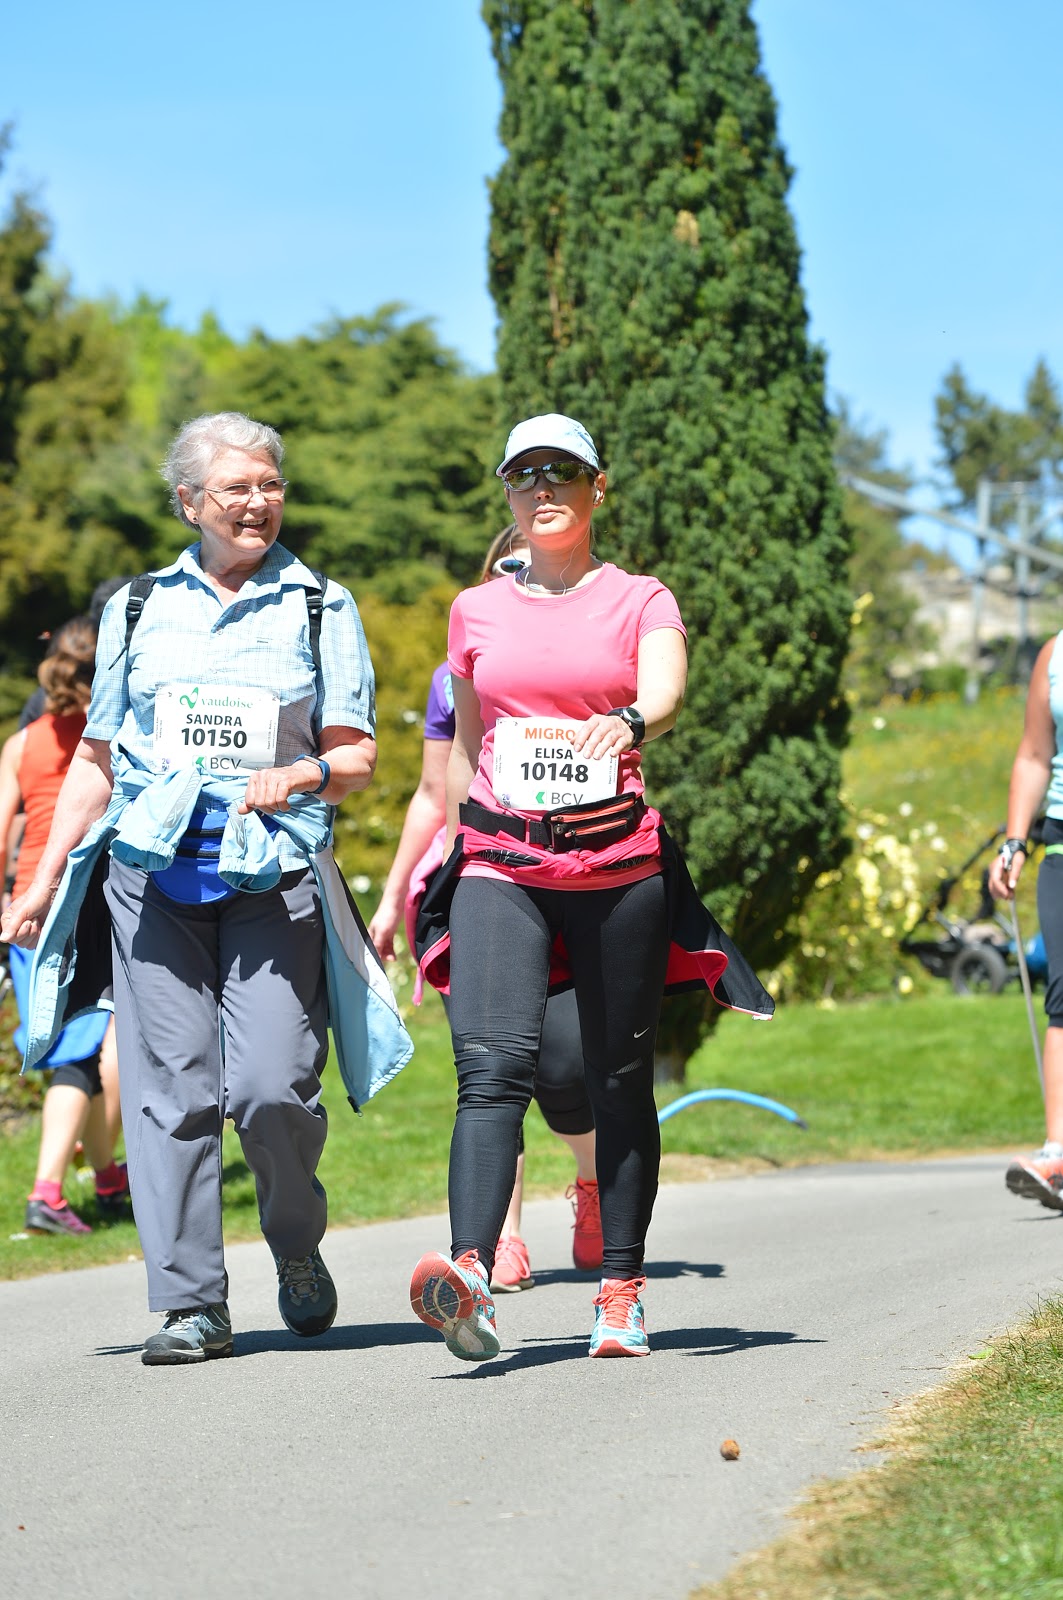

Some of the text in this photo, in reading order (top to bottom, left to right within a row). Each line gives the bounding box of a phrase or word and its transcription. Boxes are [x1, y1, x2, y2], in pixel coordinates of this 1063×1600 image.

[201, 696, 253, 709] vaudoise
[186, 714, 242, 727] SANDRA
[181, 728, 247, 749] 10150
[524, 727, 576, 741] MIGRO
[535, 748, 573, 760] ELISA
[210, 757, 242, 770] BCV
[520, 762, 589, 783] 10148
[551, 792, 584, 806] BCV
